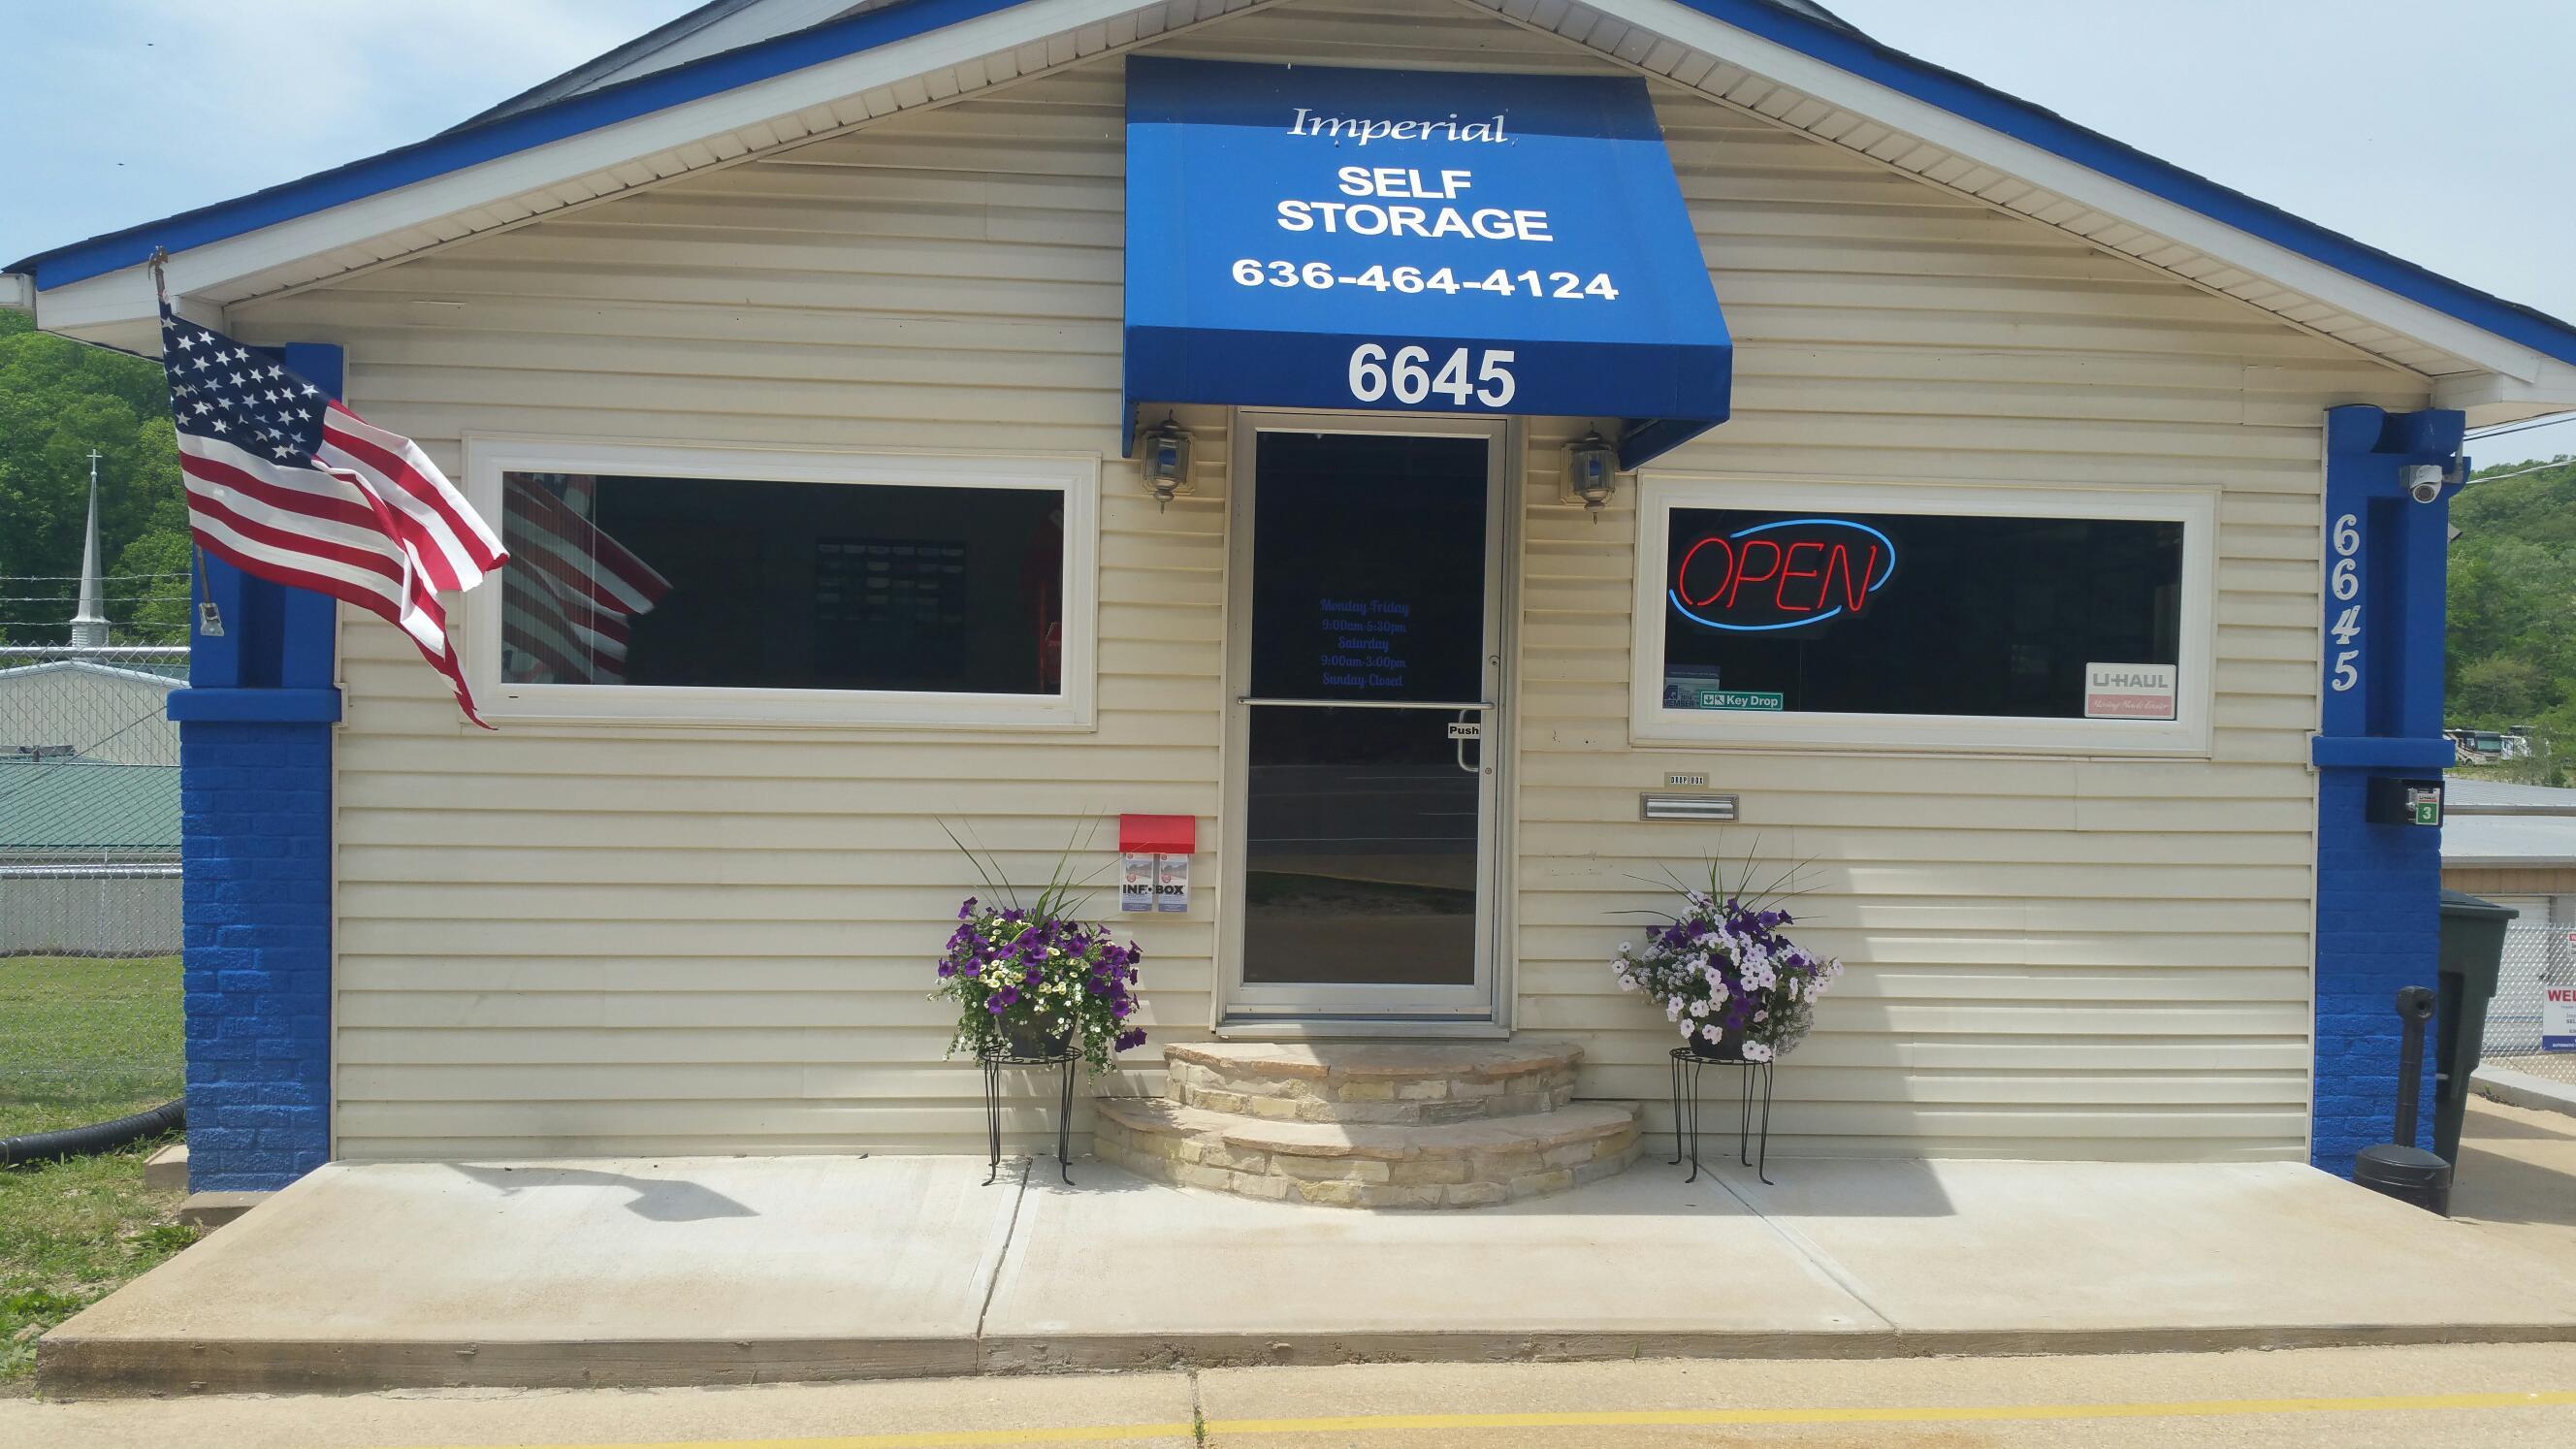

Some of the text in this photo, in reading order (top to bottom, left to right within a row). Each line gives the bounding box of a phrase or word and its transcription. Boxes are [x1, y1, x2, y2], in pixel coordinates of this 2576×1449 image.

[1286, 108, 1509, 146] Imperial
[1337, 166, 1472, 200] SELF
[1276, 200, 1554, 242] STORAGE
[1232, 258, 1620, 301] 636-464-4124
[1348, 343, 1516, 407] 6645
[1679, 537, 1878, 612] OPEN
[2331, 513, 2361, 692] 6645
[1338, 636, 1389, 652] Saturday
[2093, 673, 2169, 688] U-HAUL
[1726, 695, 1778, 707] Key Drop
[1449, 725, 1479, 735] Push
[2422, 806, 2431, 820] 3
[1155, 885, 1184, 895] BOX
